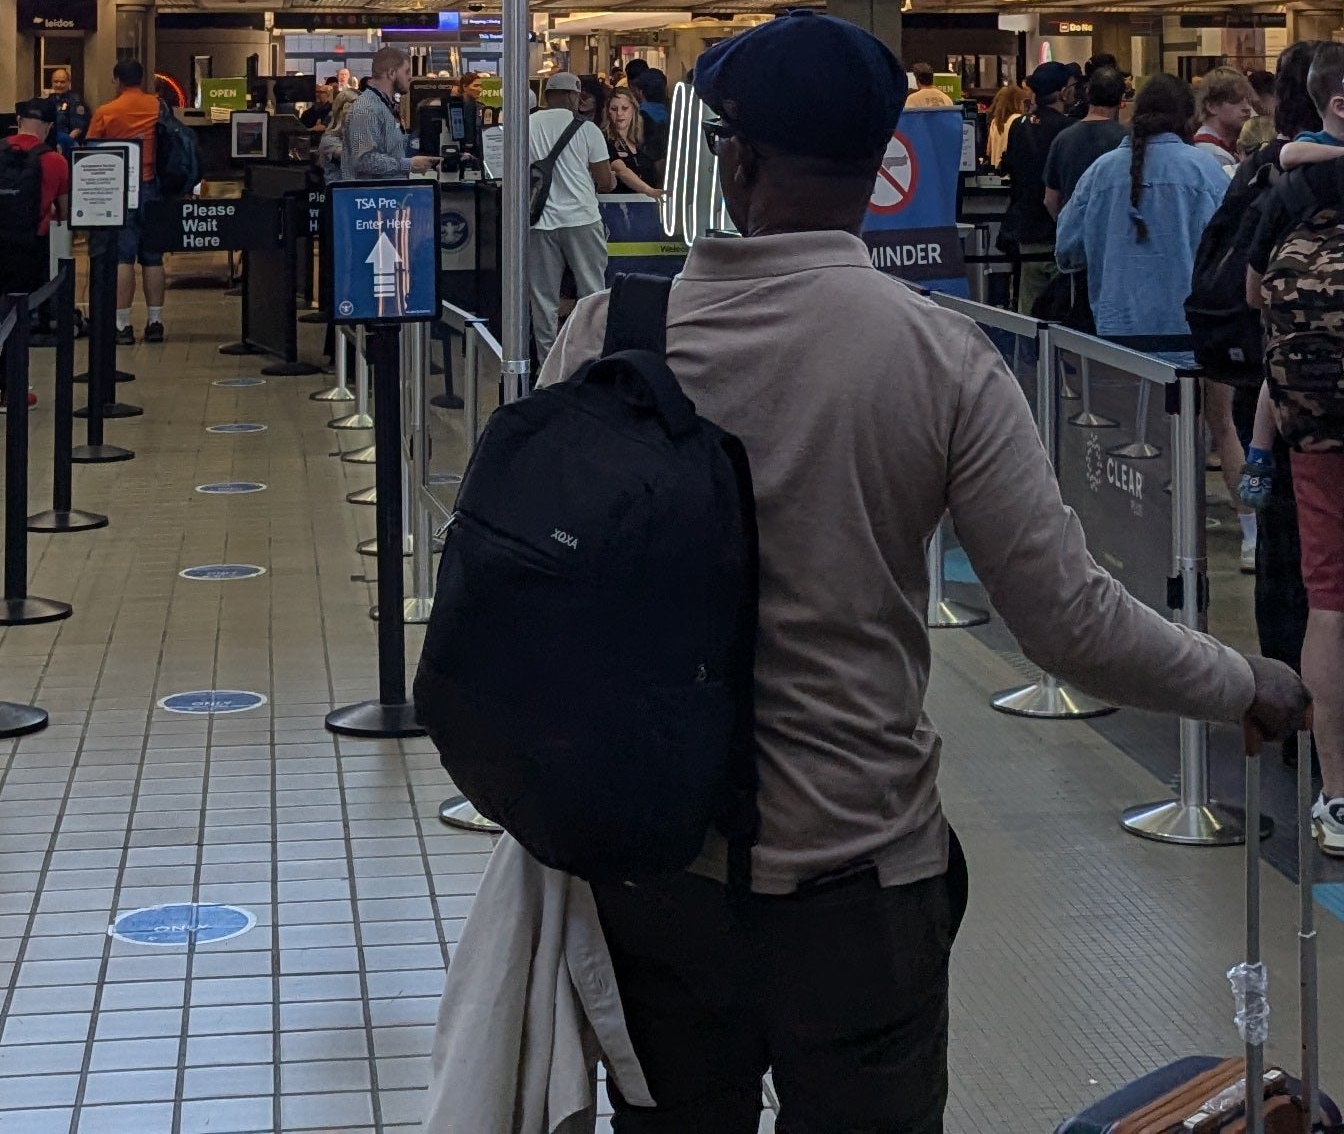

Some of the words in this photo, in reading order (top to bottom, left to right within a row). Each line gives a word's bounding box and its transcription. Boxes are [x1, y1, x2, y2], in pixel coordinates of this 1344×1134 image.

[44, 18, 74, 28] leidos
[1081, 23, 1093, 32] No
[209, 88, 237, 98] OPEN
[308, 192, 326, 203] Ple
[355, 198, 376, 209] TSA
[378, 197, 397, 209] Pre
[182, 203, 236, 217] Please
[182, 219, 218, 232] Wait
[356, 219, 384, 230] Enter
[386, 218, 412, 229] Here
[183, 235, 220, 247] Here
[660, 244, 689, 253] Welco
[869, 242, 942, 268] MINDER
[1106, 457, 1143, 500] CLEAR
